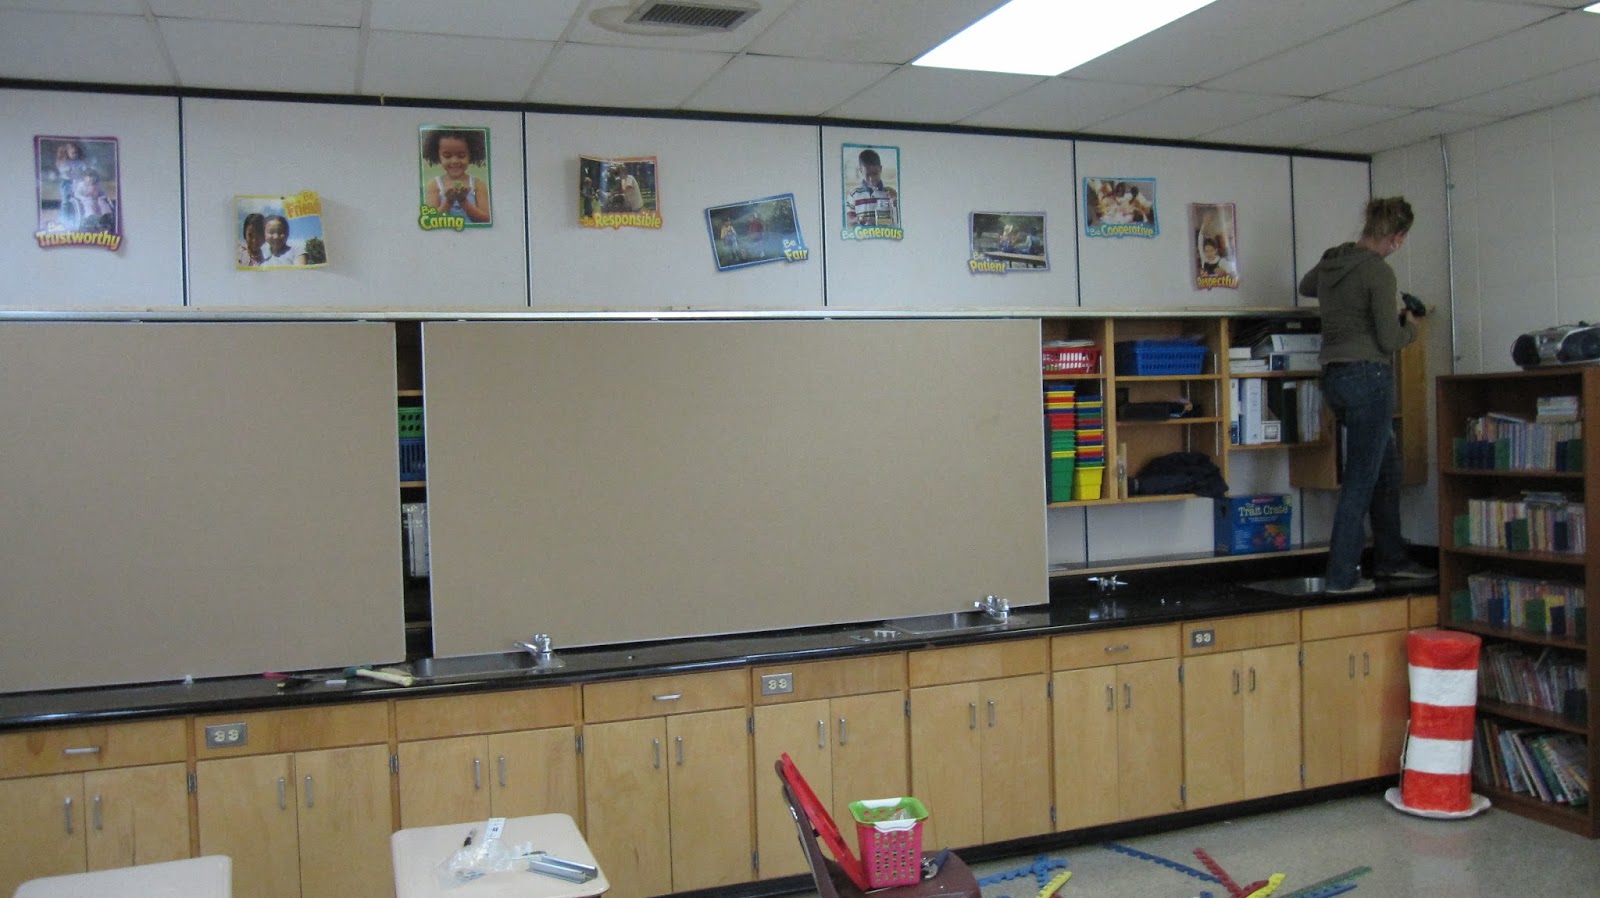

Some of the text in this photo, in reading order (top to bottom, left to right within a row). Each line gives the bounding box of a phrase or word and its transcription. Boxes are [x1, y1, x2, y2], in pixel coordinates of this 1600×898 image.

[420, 205, 437, 215] Be
[420, 212, 464, 231] Caring
[594, 210, 660, 229] Responsible
[854, 225, 902, 239] Generous
[1100, 223, 1154, 237] Cooperative
[36, 230, 121, 250] Trustworthy
[783, 239, 796, 249] Be
[784, 247, 808, 261] Fair
[969, 259, 1006, 273] Patient
[1197, 275, 1239, 288] Respectful
[1238, 504, 1288, 517] Trait Crate
